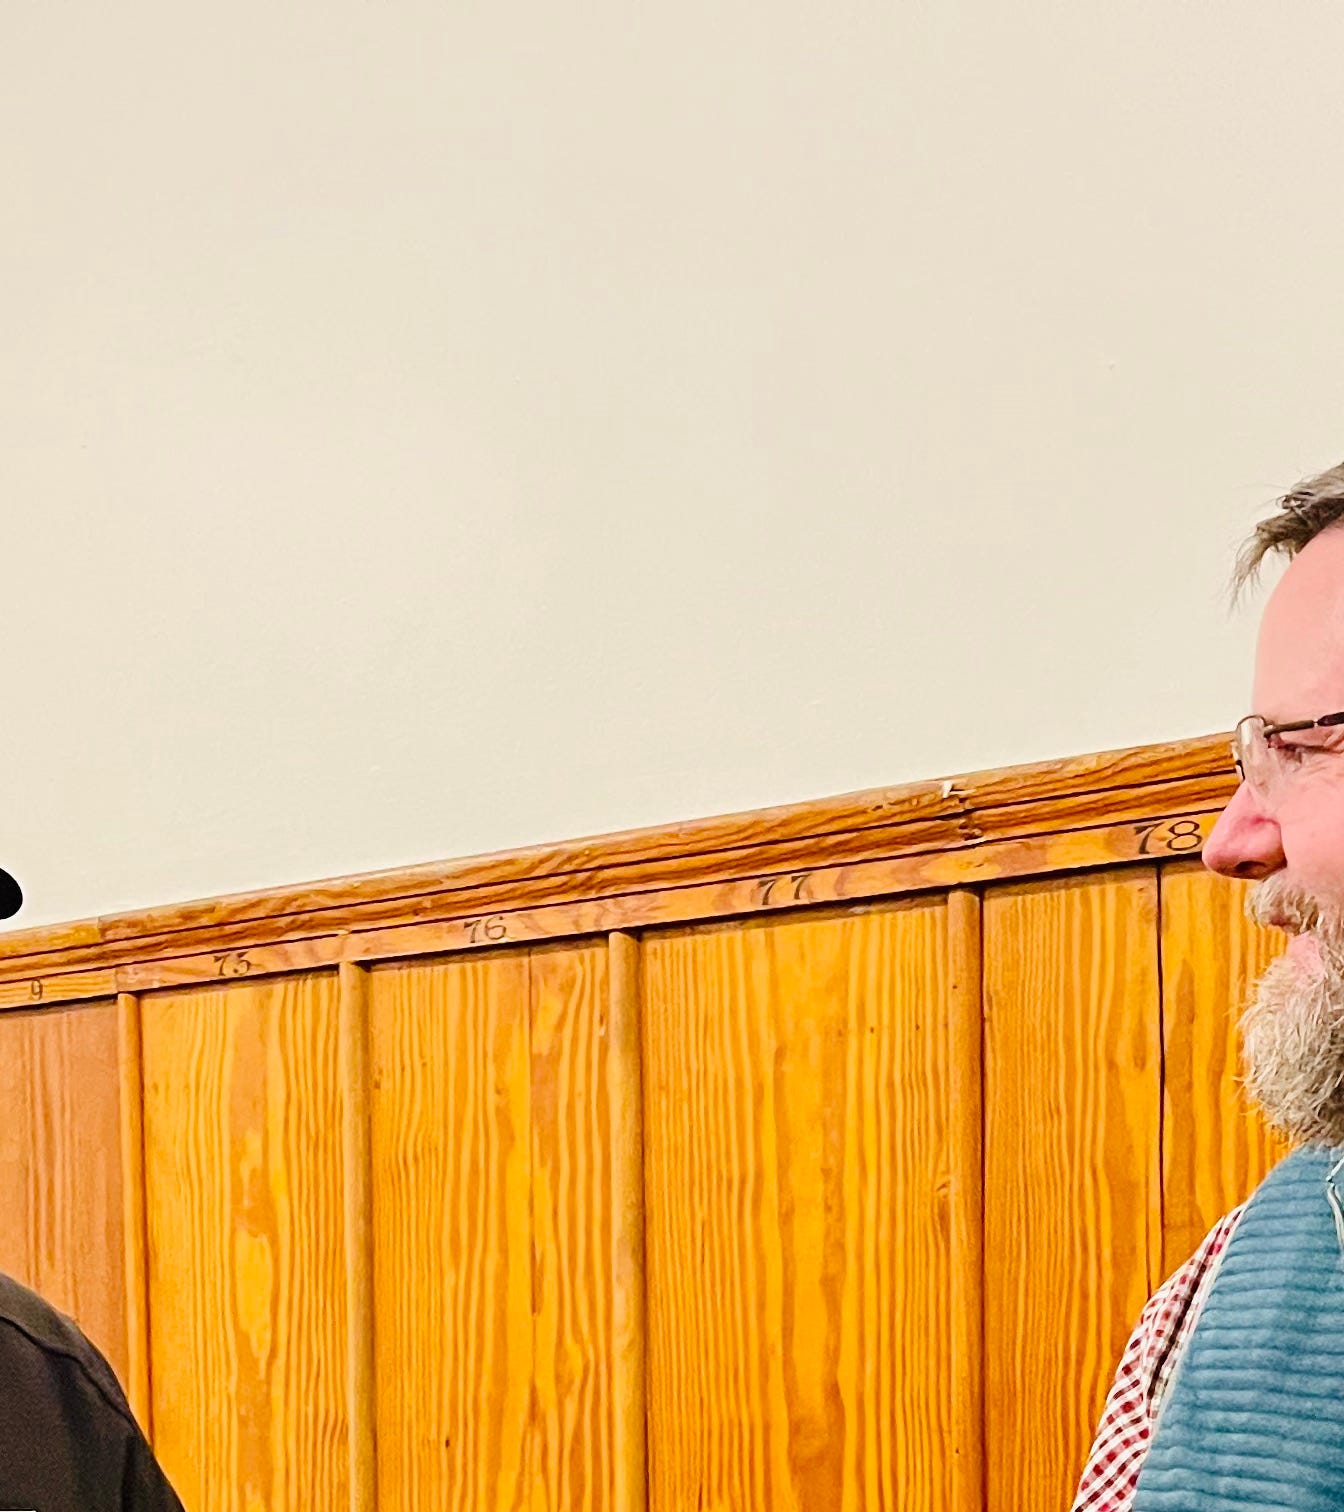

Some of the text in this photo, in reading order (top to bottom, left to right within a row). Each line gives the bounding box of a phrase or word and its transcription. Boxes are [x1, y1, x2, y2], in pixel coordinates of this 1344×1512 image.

[1134, 820, 1203, 855] 78
[757, 872, 813, 906] 77
[463, 914, 507, 944] 76
[213, 951, 252, 977] 75
